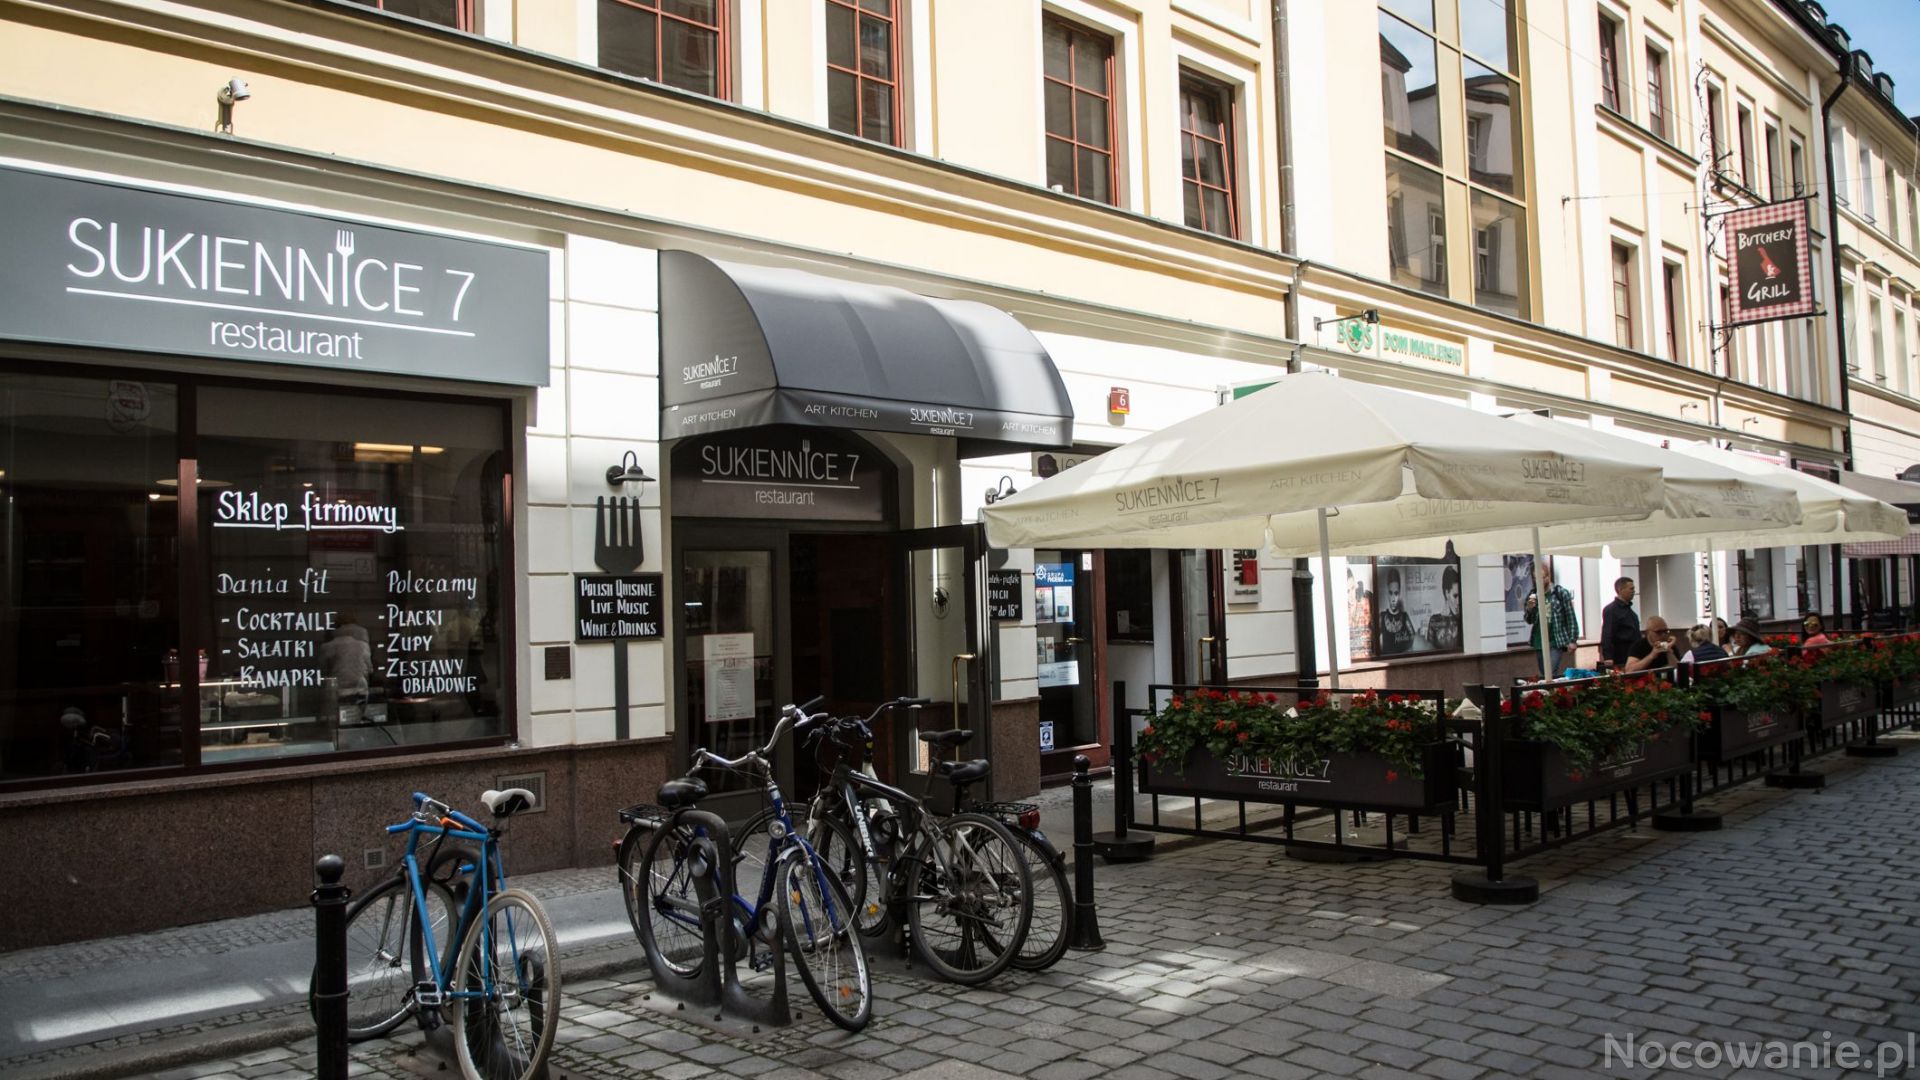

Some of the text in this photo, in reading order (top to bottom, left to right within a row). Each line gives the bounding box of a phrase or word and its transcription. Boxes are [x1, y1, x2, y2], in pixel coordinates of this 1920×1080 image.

[1738, 228, 1793, 250] BUTCHERY
[66, 217, 476, 322] SUKIENNICE 7
[1747, 282, 1791, 302] GRILL
[210, 320, 364, 360] restaurant
[683, 355, 738, 381] SUKIENNICE 7
[1120, 395, 1126, 406] 6
[682, 409, 736, 425] ART KITCHEN
[804, 404, 878, 419] ART KITCHEN
[910, 408, 974, 426] SUKIENNICE 7
[930, 427, 955, 436] restaurant
[1002, 421, 1056, 436] ART KITCHEN
[702, 441, 860, 482] SUKIENNICE 7
[1520, 456, 1578, 482] SUKIENNICE
[1269, 470, 1362, 490] ART KITCHEN
[755, 488, 815, 505] restaurant
[1115, 478, 1221, 511] SUKIENNICE 7
[217, 490, 397, 534] Sklep firmowy
[217, 567, 289, 594] Dania
[386, 569, 477, 600] Polecamy
[580, 579, 657, 598] POLISH QUISINE
[591, 599, 650, 615] LIVE MUSIC
[237, 607, 338, 632] COCKTAILE
[238, 637, 314, 659] SAŁATKI
[240, 665, 321, 689] KANAPKI
[402, 676, 477, 694] OBIADOWE
[1321, 759, 1331, 778] 7
[1258, 780, 1298, 792] restaurant
